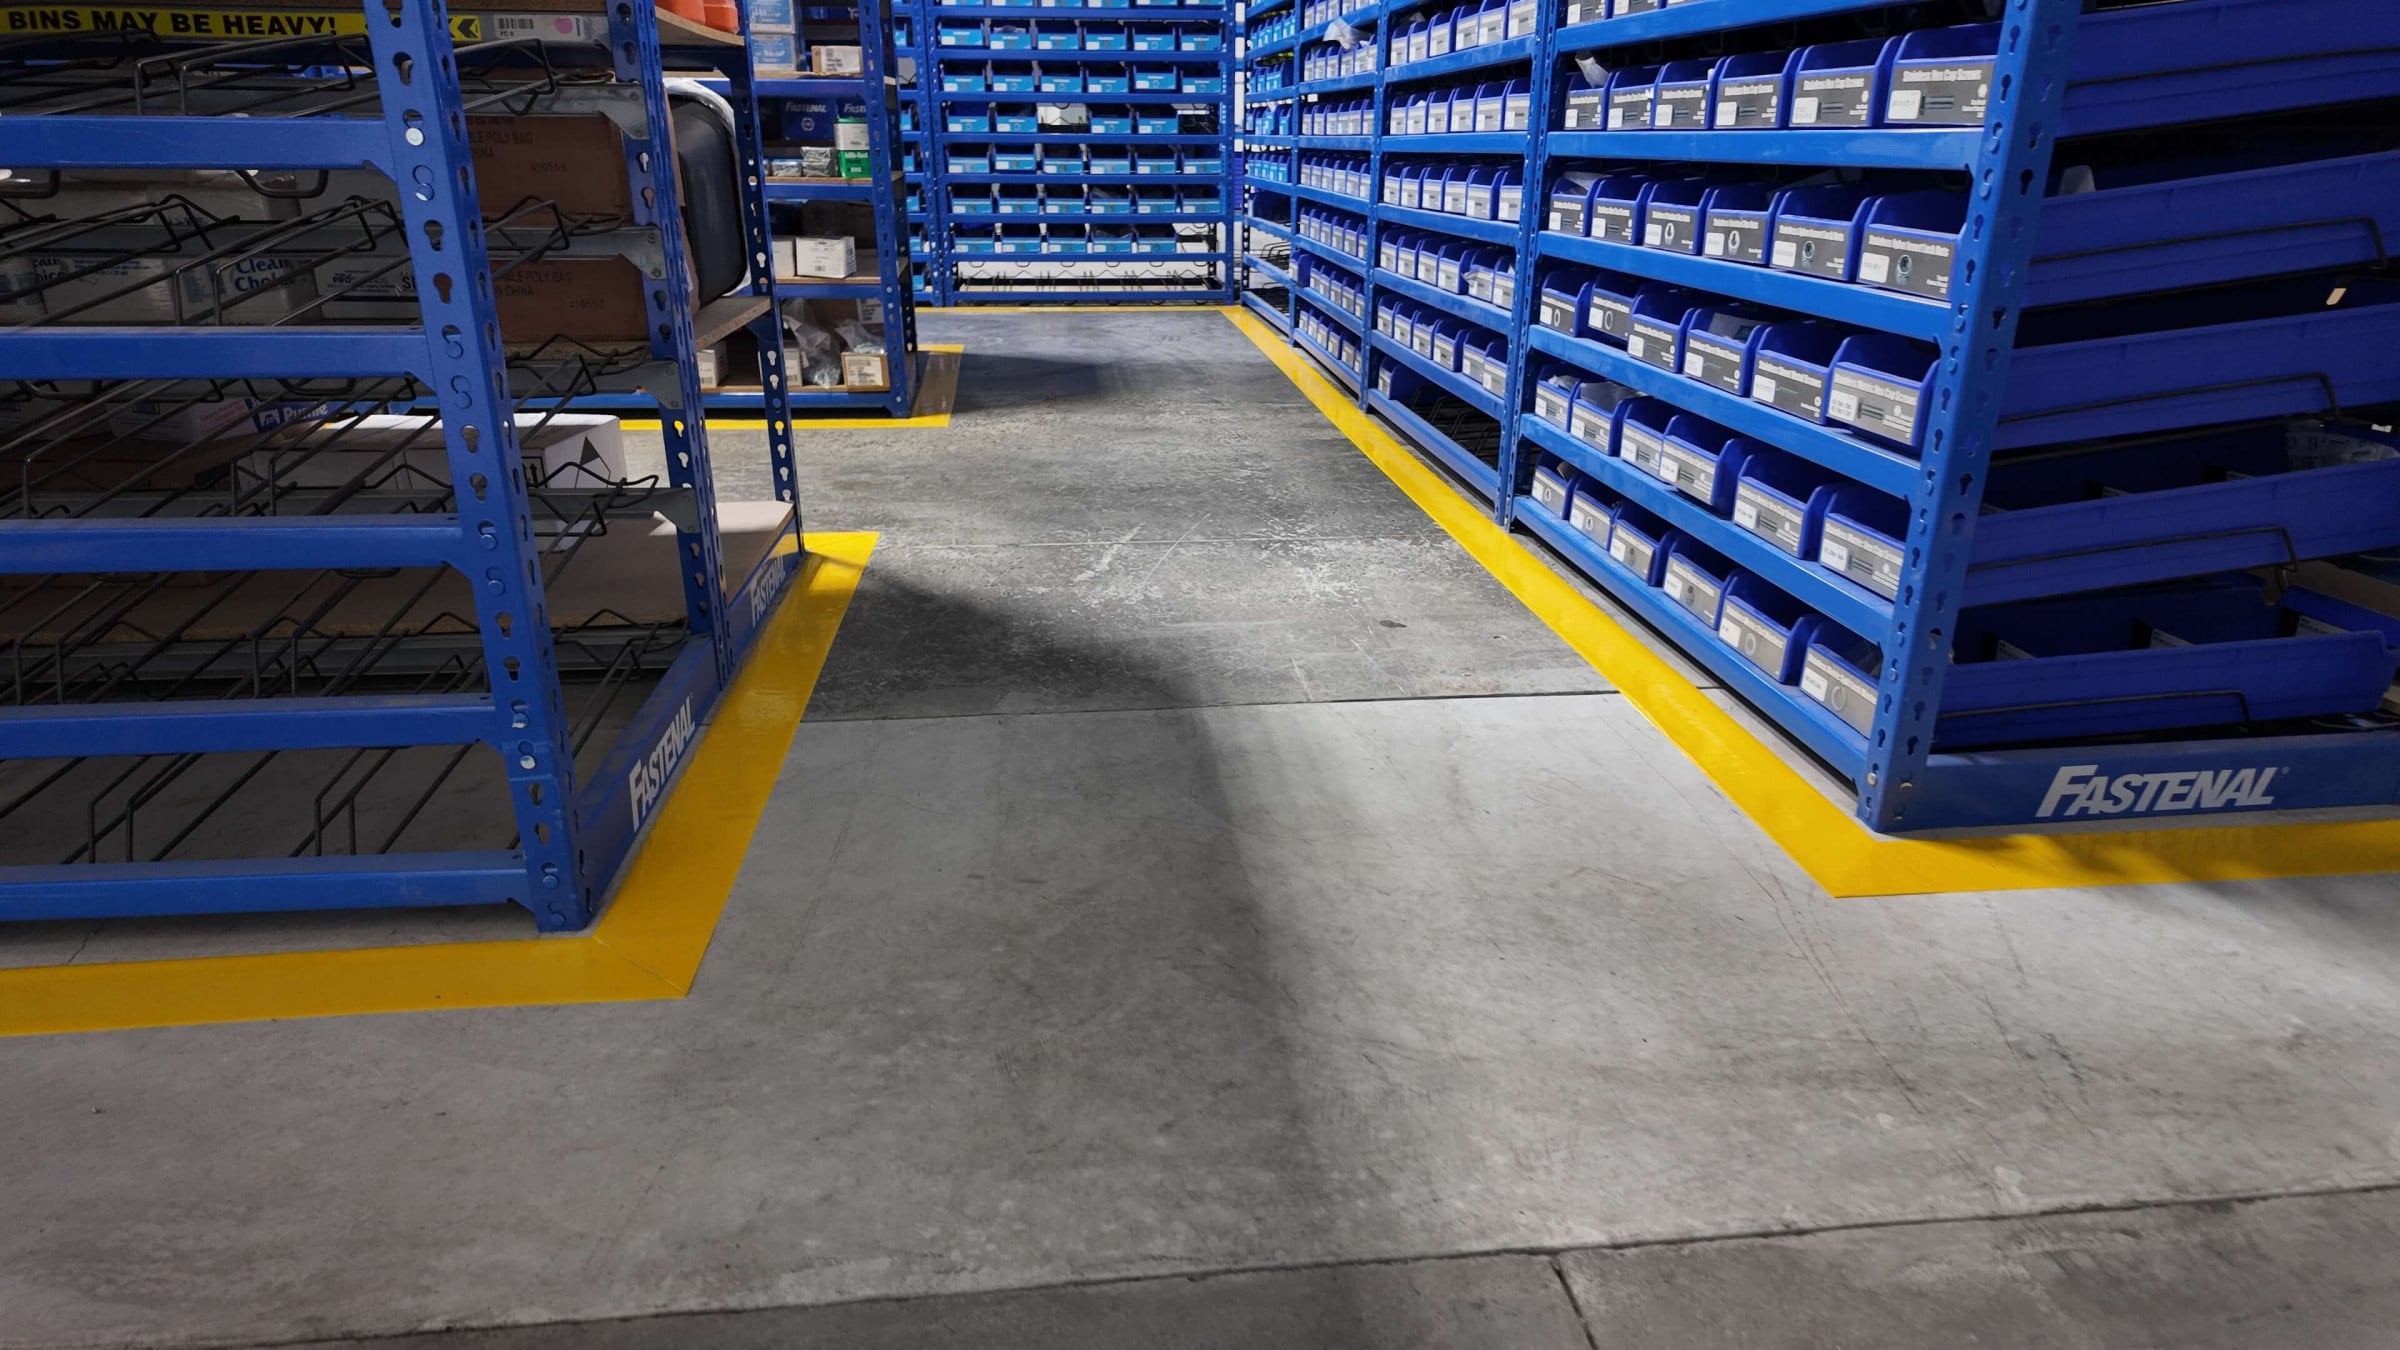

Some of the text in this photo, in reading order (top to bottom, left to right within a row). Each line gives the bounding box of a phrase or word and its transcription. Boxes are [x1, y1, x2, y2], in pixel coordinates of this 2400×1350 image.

[10, 10, 337, 36] BINS MAY BE HEAVY!
[750, 554, 786, 628] FASTENAL
[628, 696, 696, 833] FASTENAL
[2034, 763, 2277, 818] FASTENAL
